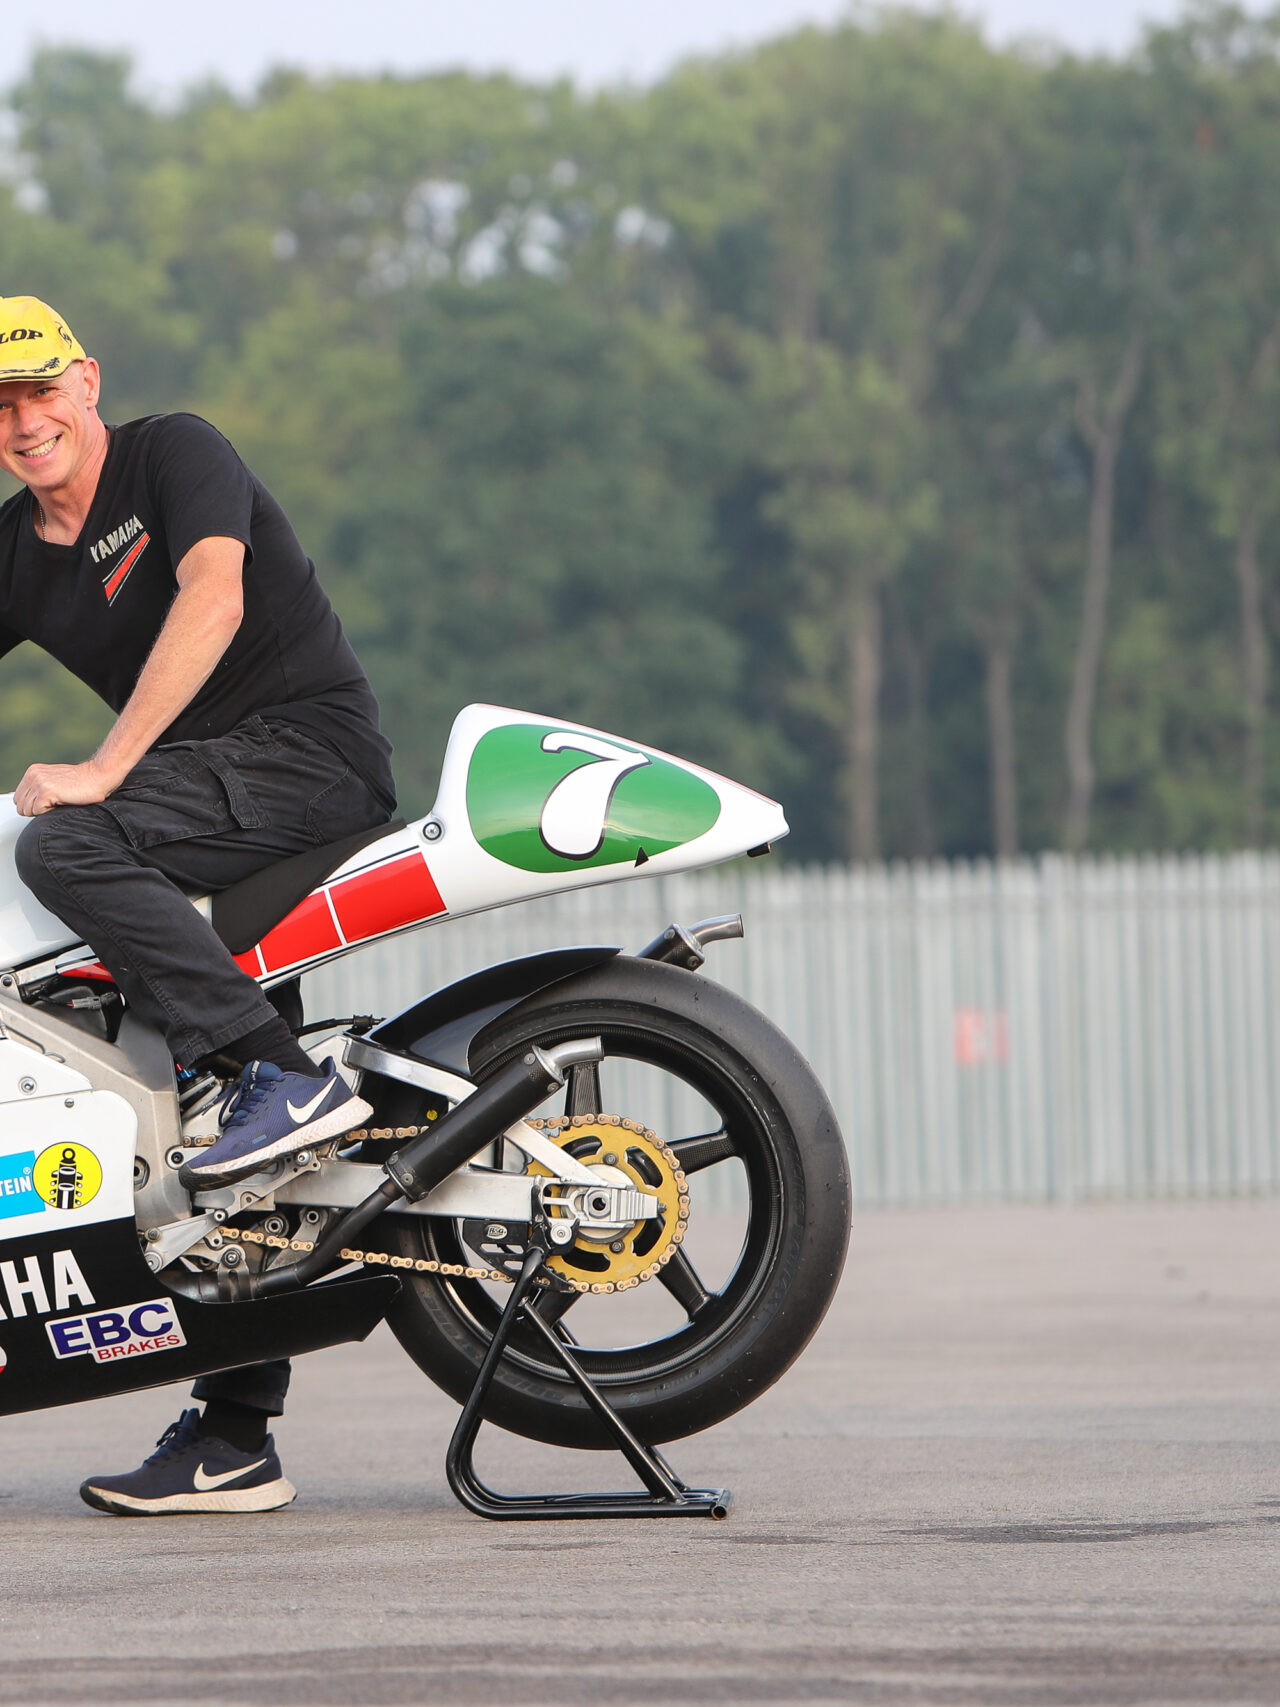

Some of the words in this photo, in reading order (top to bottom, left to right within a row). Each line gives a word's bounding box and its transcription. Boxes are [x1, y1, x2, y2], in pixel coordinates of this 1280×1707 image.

[90, 514, 144, 563] YAMAHA
[539, 731, 652, 861] 7
[50, 1303, 173, 1356] EBC
[97, 1334, 181, 1360] BRAKES
